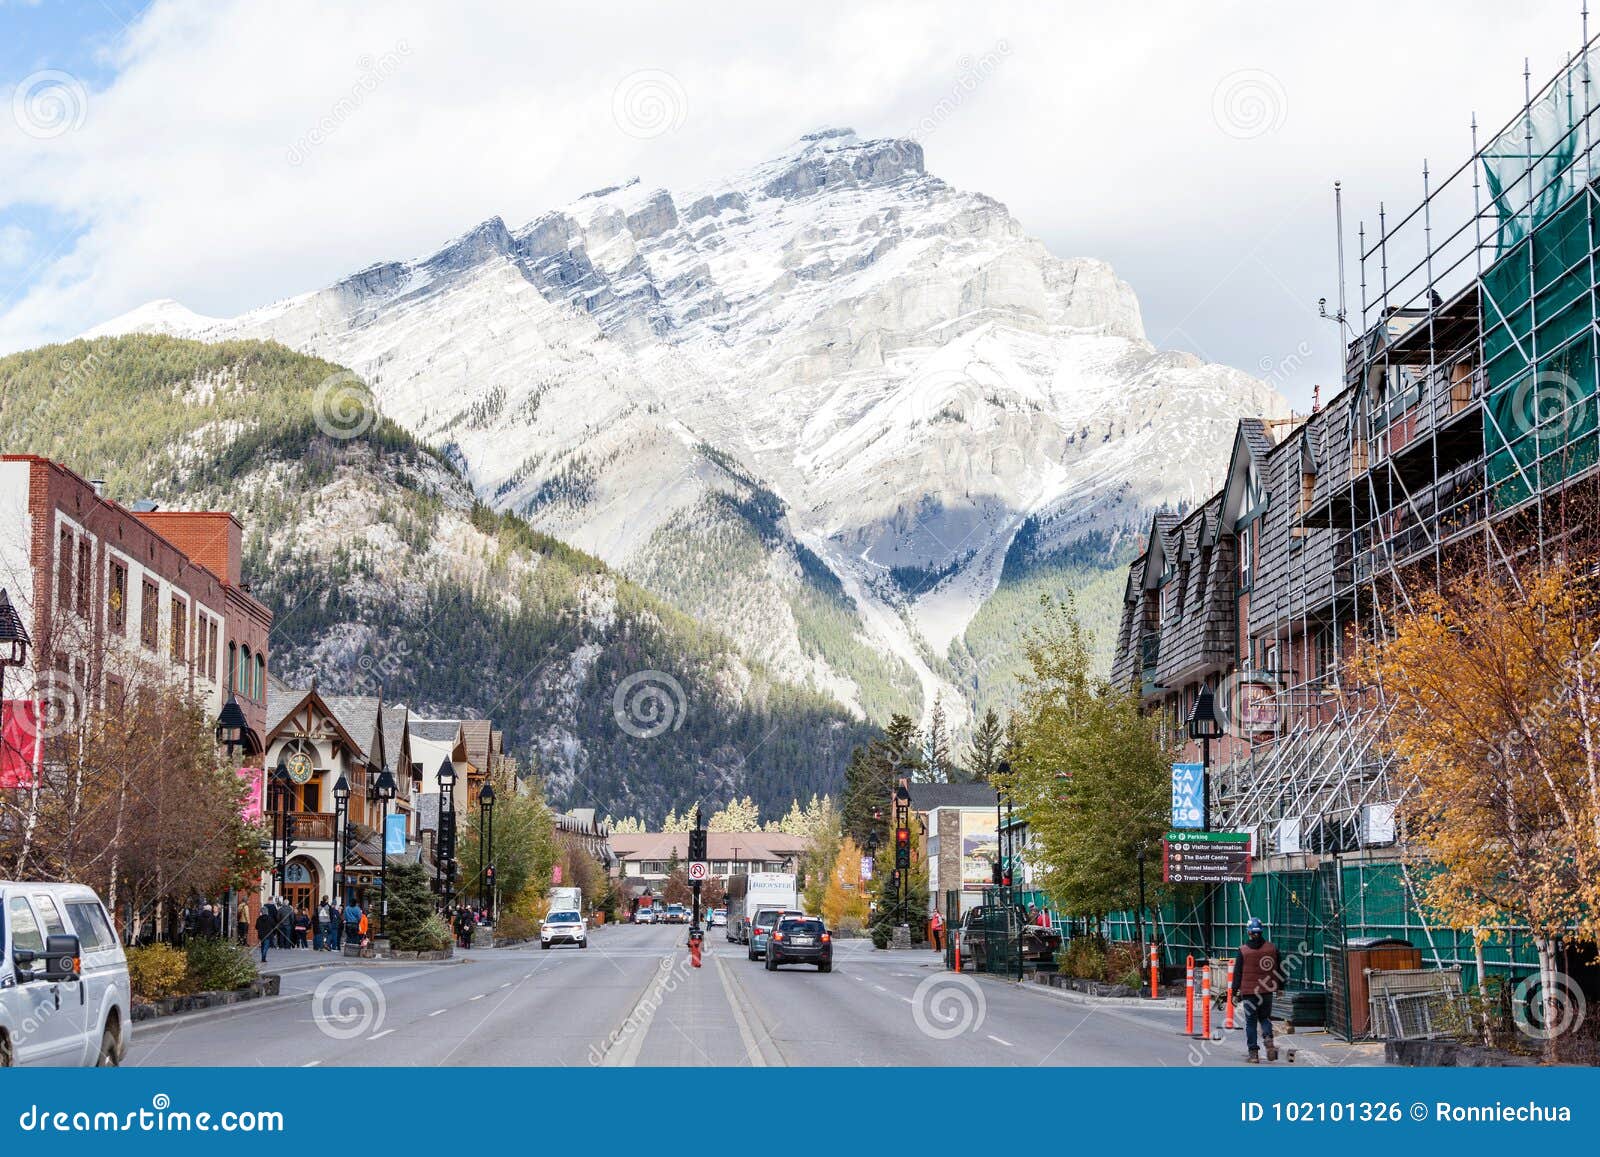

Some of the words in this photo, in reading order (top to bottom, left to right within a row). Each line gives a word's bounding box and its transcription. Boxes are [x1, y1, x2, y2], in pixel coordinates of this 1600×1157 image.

[1173, 769, 1193, 781] CA
[1173, 781, 1193, 794] NA
[1173, 795, 1193, 808] DA
